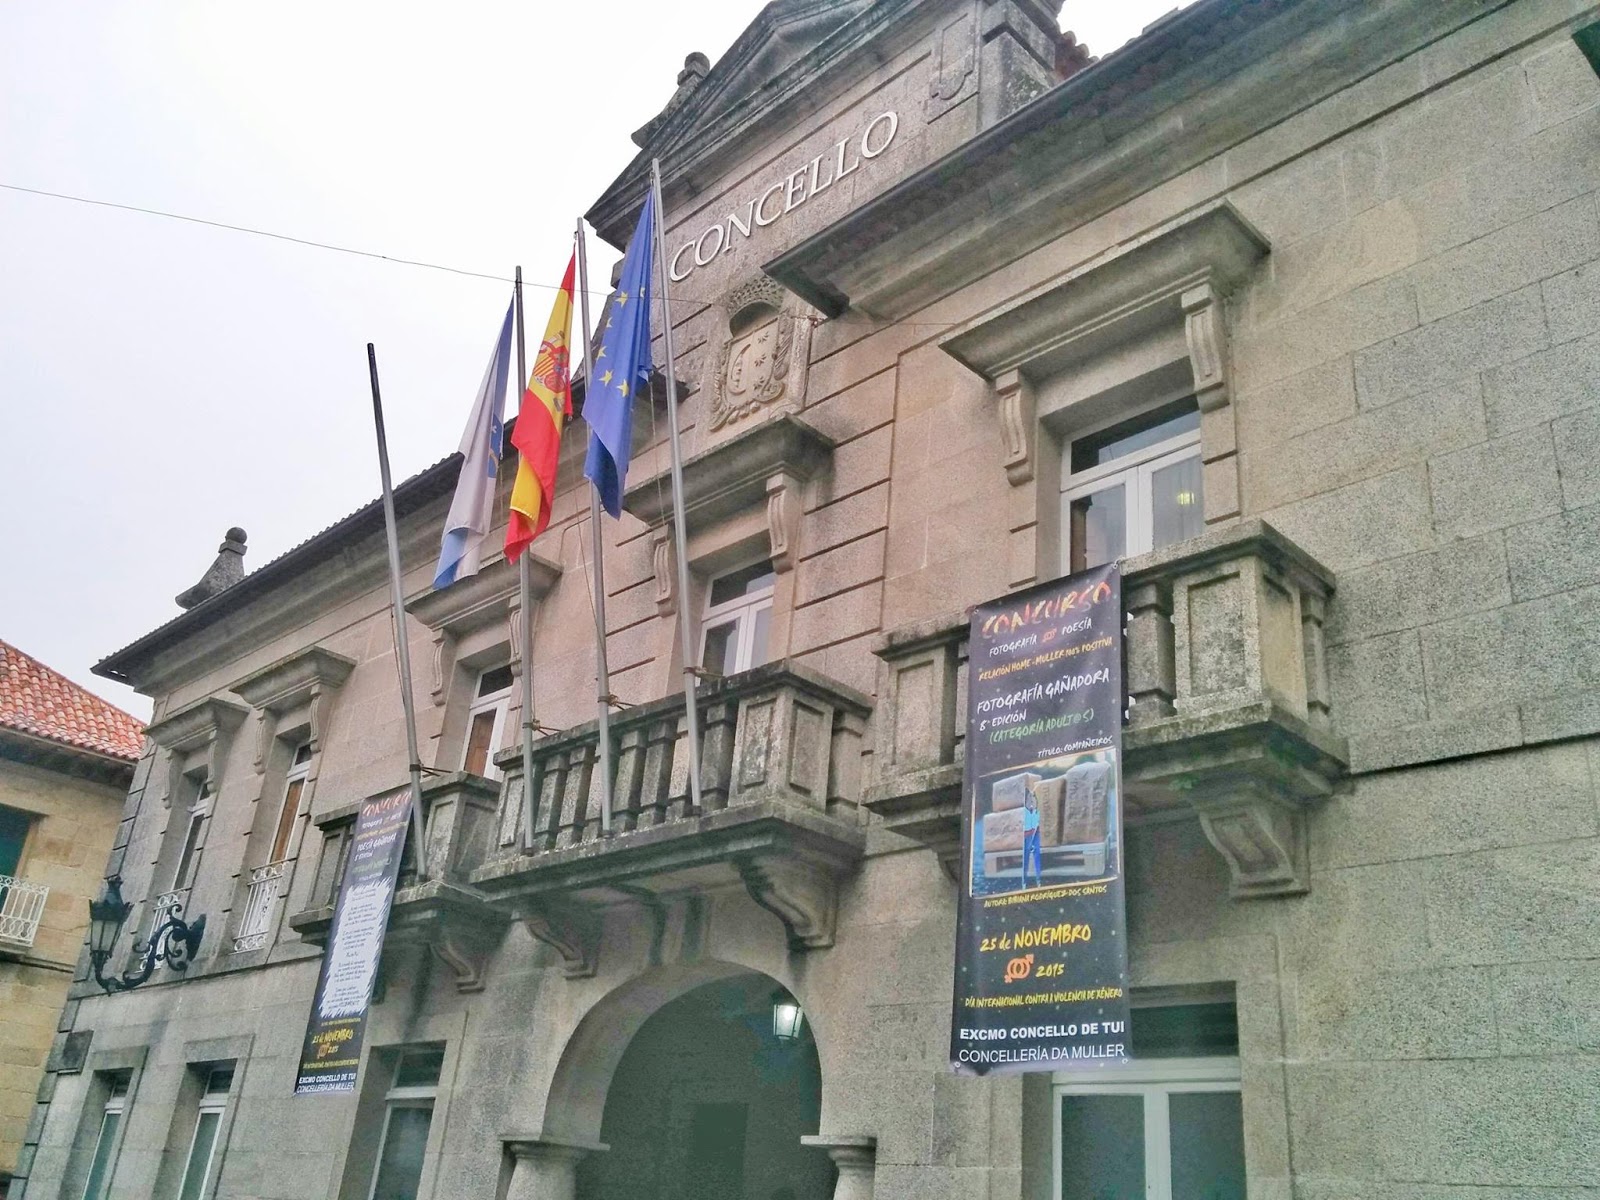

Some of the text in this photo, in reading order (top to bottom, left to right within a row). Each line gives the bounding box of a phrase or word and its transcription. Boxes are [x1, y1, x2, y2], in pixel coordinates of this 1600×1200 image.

[670, 111, 898, 282] CONCELLO
[982, 581, 1112, 638] CONCURSO
[989, 618, 1092, 657] FOTOGRAFÍA POESÍA
[978, 663, 1011, 681] RELACIÓN
[1081, 637, 1113, 652] POSITIVA
[977, 668, 1110, 714] FOTOGRAFÍA GAÑADORA
[992, 709, 1027, 728] EDICIÓN
[989, 720, 1044, 744] (CATEGORÍA
[1037, 735, 1113, 758] TÍTULO: COMPAÑEIROS
[1082, 884, 1107, 895] SANTOS
[979, 923, 1092, 952] 25 de NOVEMBRO
[1035, 963, 1065, 978] 2015
[965, 995, 975, 1007] DÍA
[977, 994, 1024, 1008] INTERNACIONAL
[1025, 993, 1048, 1005] CONTRA
[1053, 990, 1086, 1003] VIOLENCIA
[1087, 989, 1095, 1000] DE
[1096, 986, 1123, 999] XÉNERO
[959, 1021, 1125, 1040] EXCMO CONCELLO DE TUI
[959, 1044, 1125, 1063] CONCELLERÍA DA MULLER
[299, 1076, 316, 1084] EXCMO
[316, 1074, 340, 1083] CONCELLO
[348, 1072, 356, 1080] TUI
